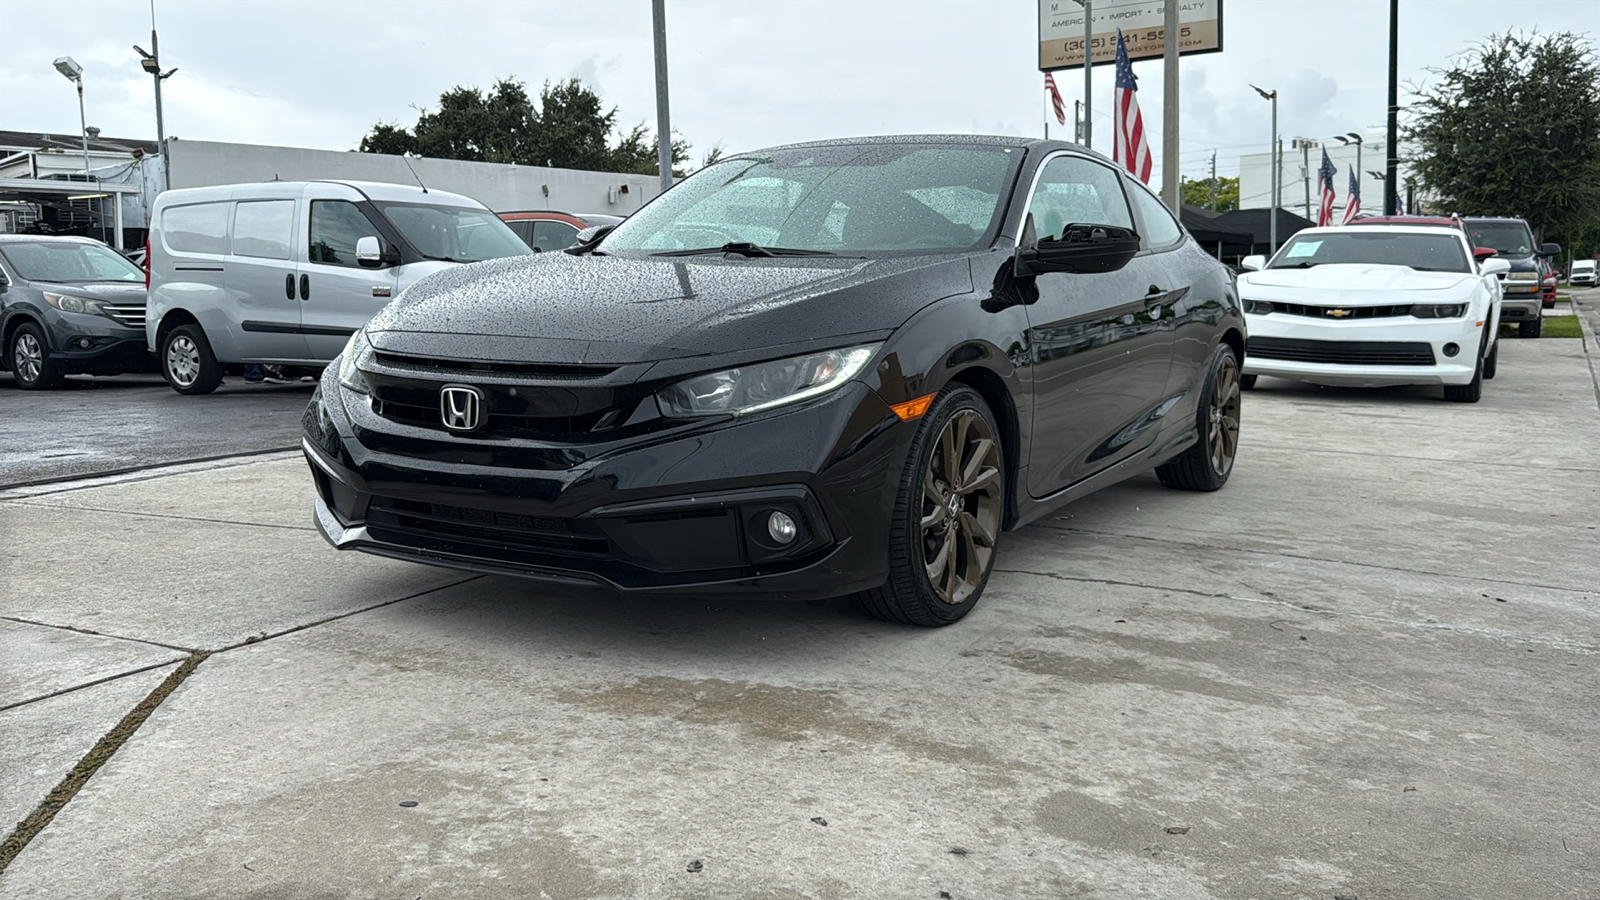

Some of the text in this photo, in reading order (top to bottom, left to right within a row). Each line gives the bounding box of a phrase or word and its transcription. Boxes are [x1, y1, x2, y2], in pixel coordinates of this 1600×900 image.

[1051, 2, 1205, 28] AMERICN IMPORT SIALTY
[1109, 27, 1191, 46] 541-555
